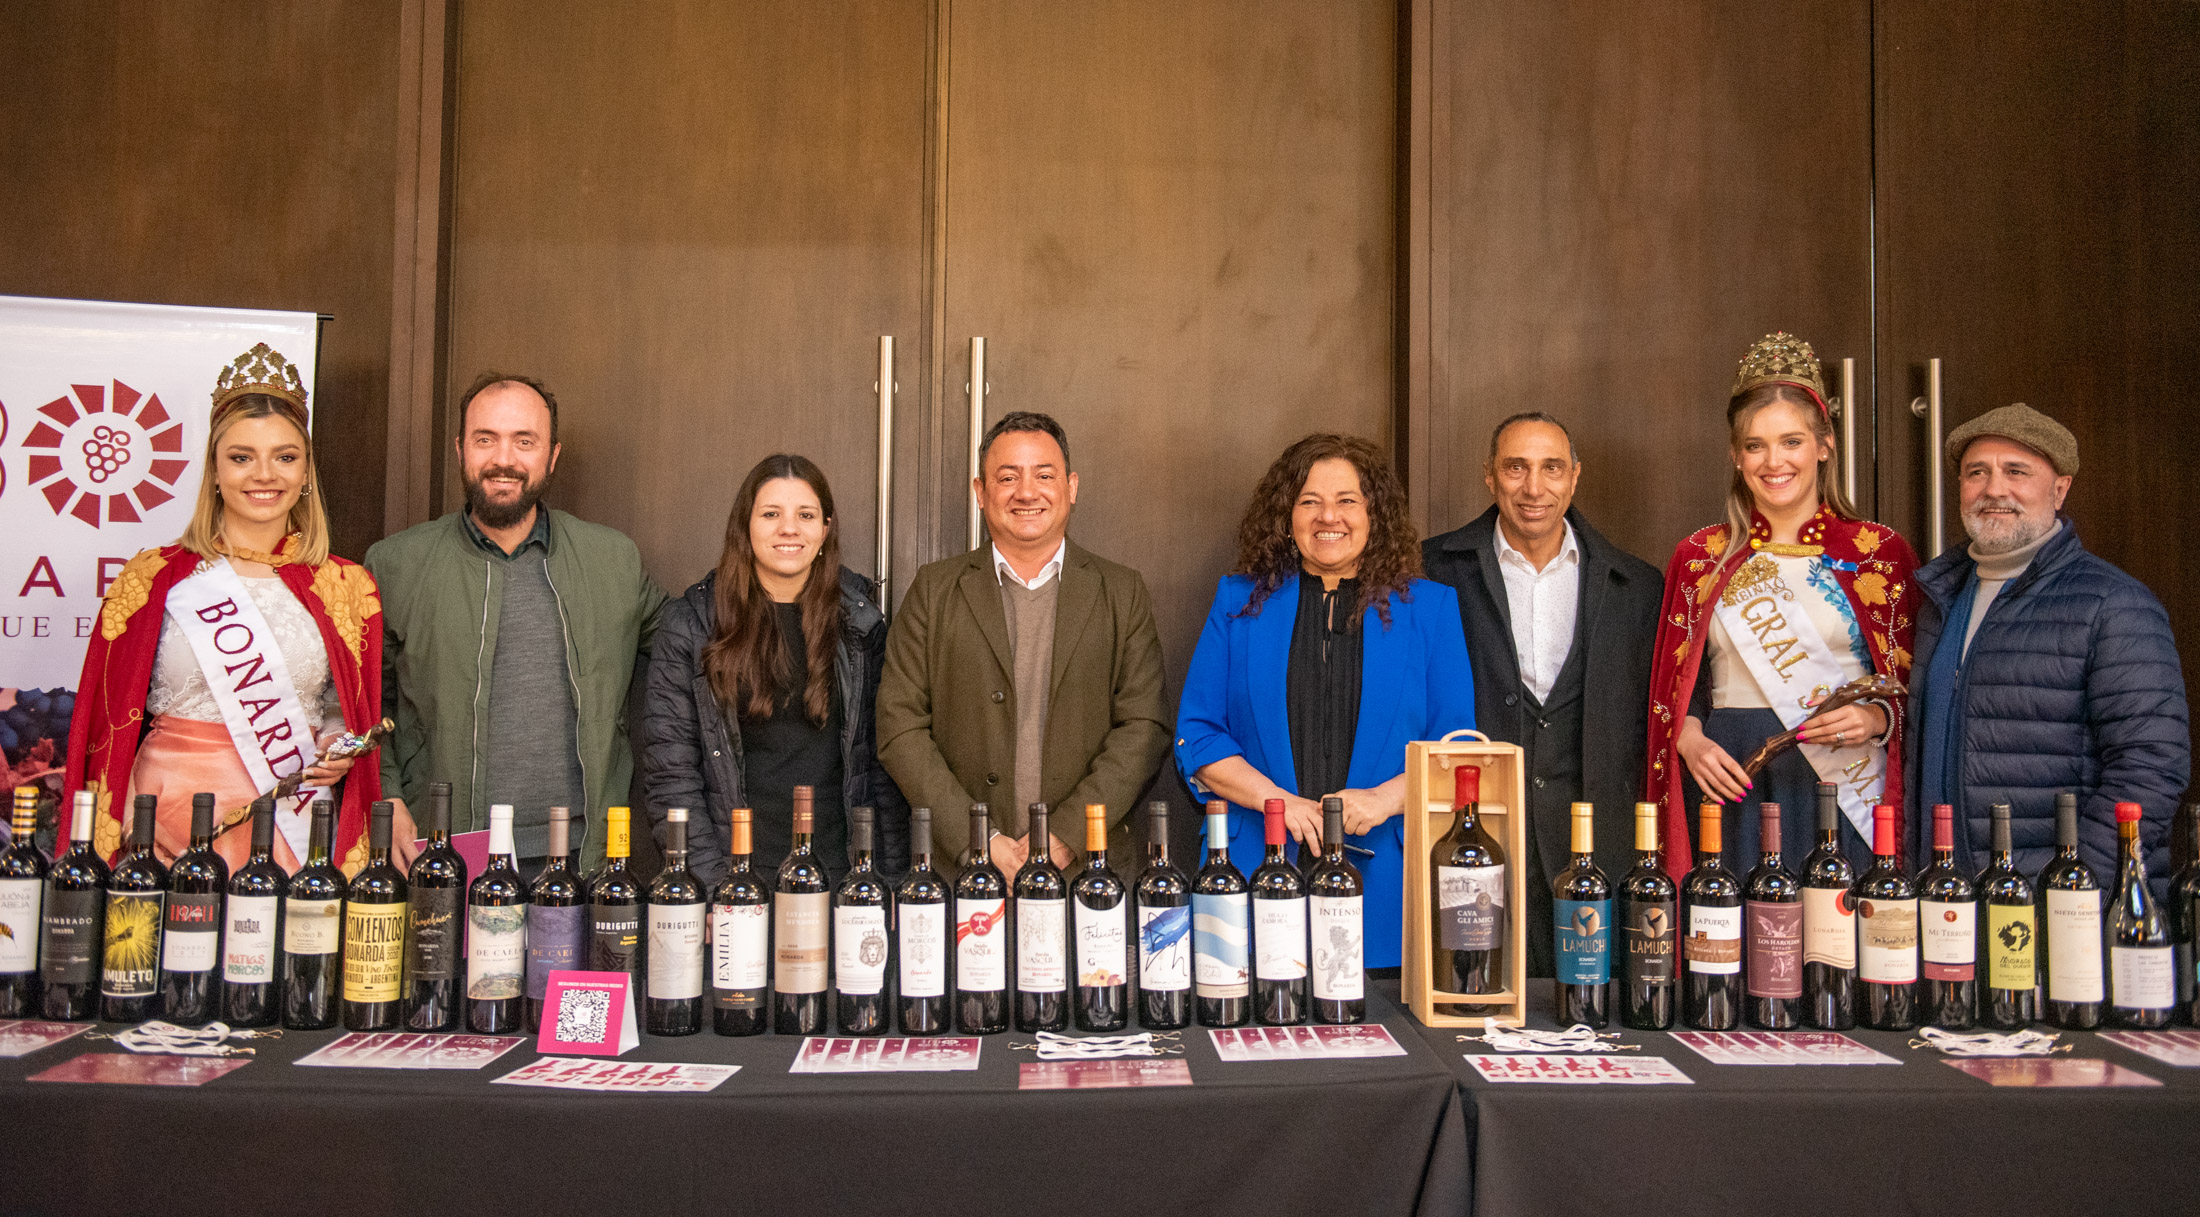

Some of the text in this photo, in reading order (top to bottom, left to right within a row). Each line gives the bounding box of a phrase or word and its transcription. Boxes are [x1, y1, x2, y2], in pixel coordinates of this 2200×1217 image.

[1740, 596, 1809, 684] GRAL.
[195, 597, 318, 816] BONARDA
[619, 833, 628, 843] 92
[1319, 907, 1361, 916] INTENSO
[657, 921, 699, 929] DURIGUTTI
[1472, 916, 1494, 924] AMICI
[1703, 918, 1730, 928] PUERTA
[596, 921, 638, 930] DURIGUTTI
[1770, 938, 1800, 946] HAROLDOS
[346, 944, 385, 962] BONARDA
[476, 947, 489, 957] DE
[532, 949, 544, 957] DE
[719, 922, 729, 981] EMILIA
